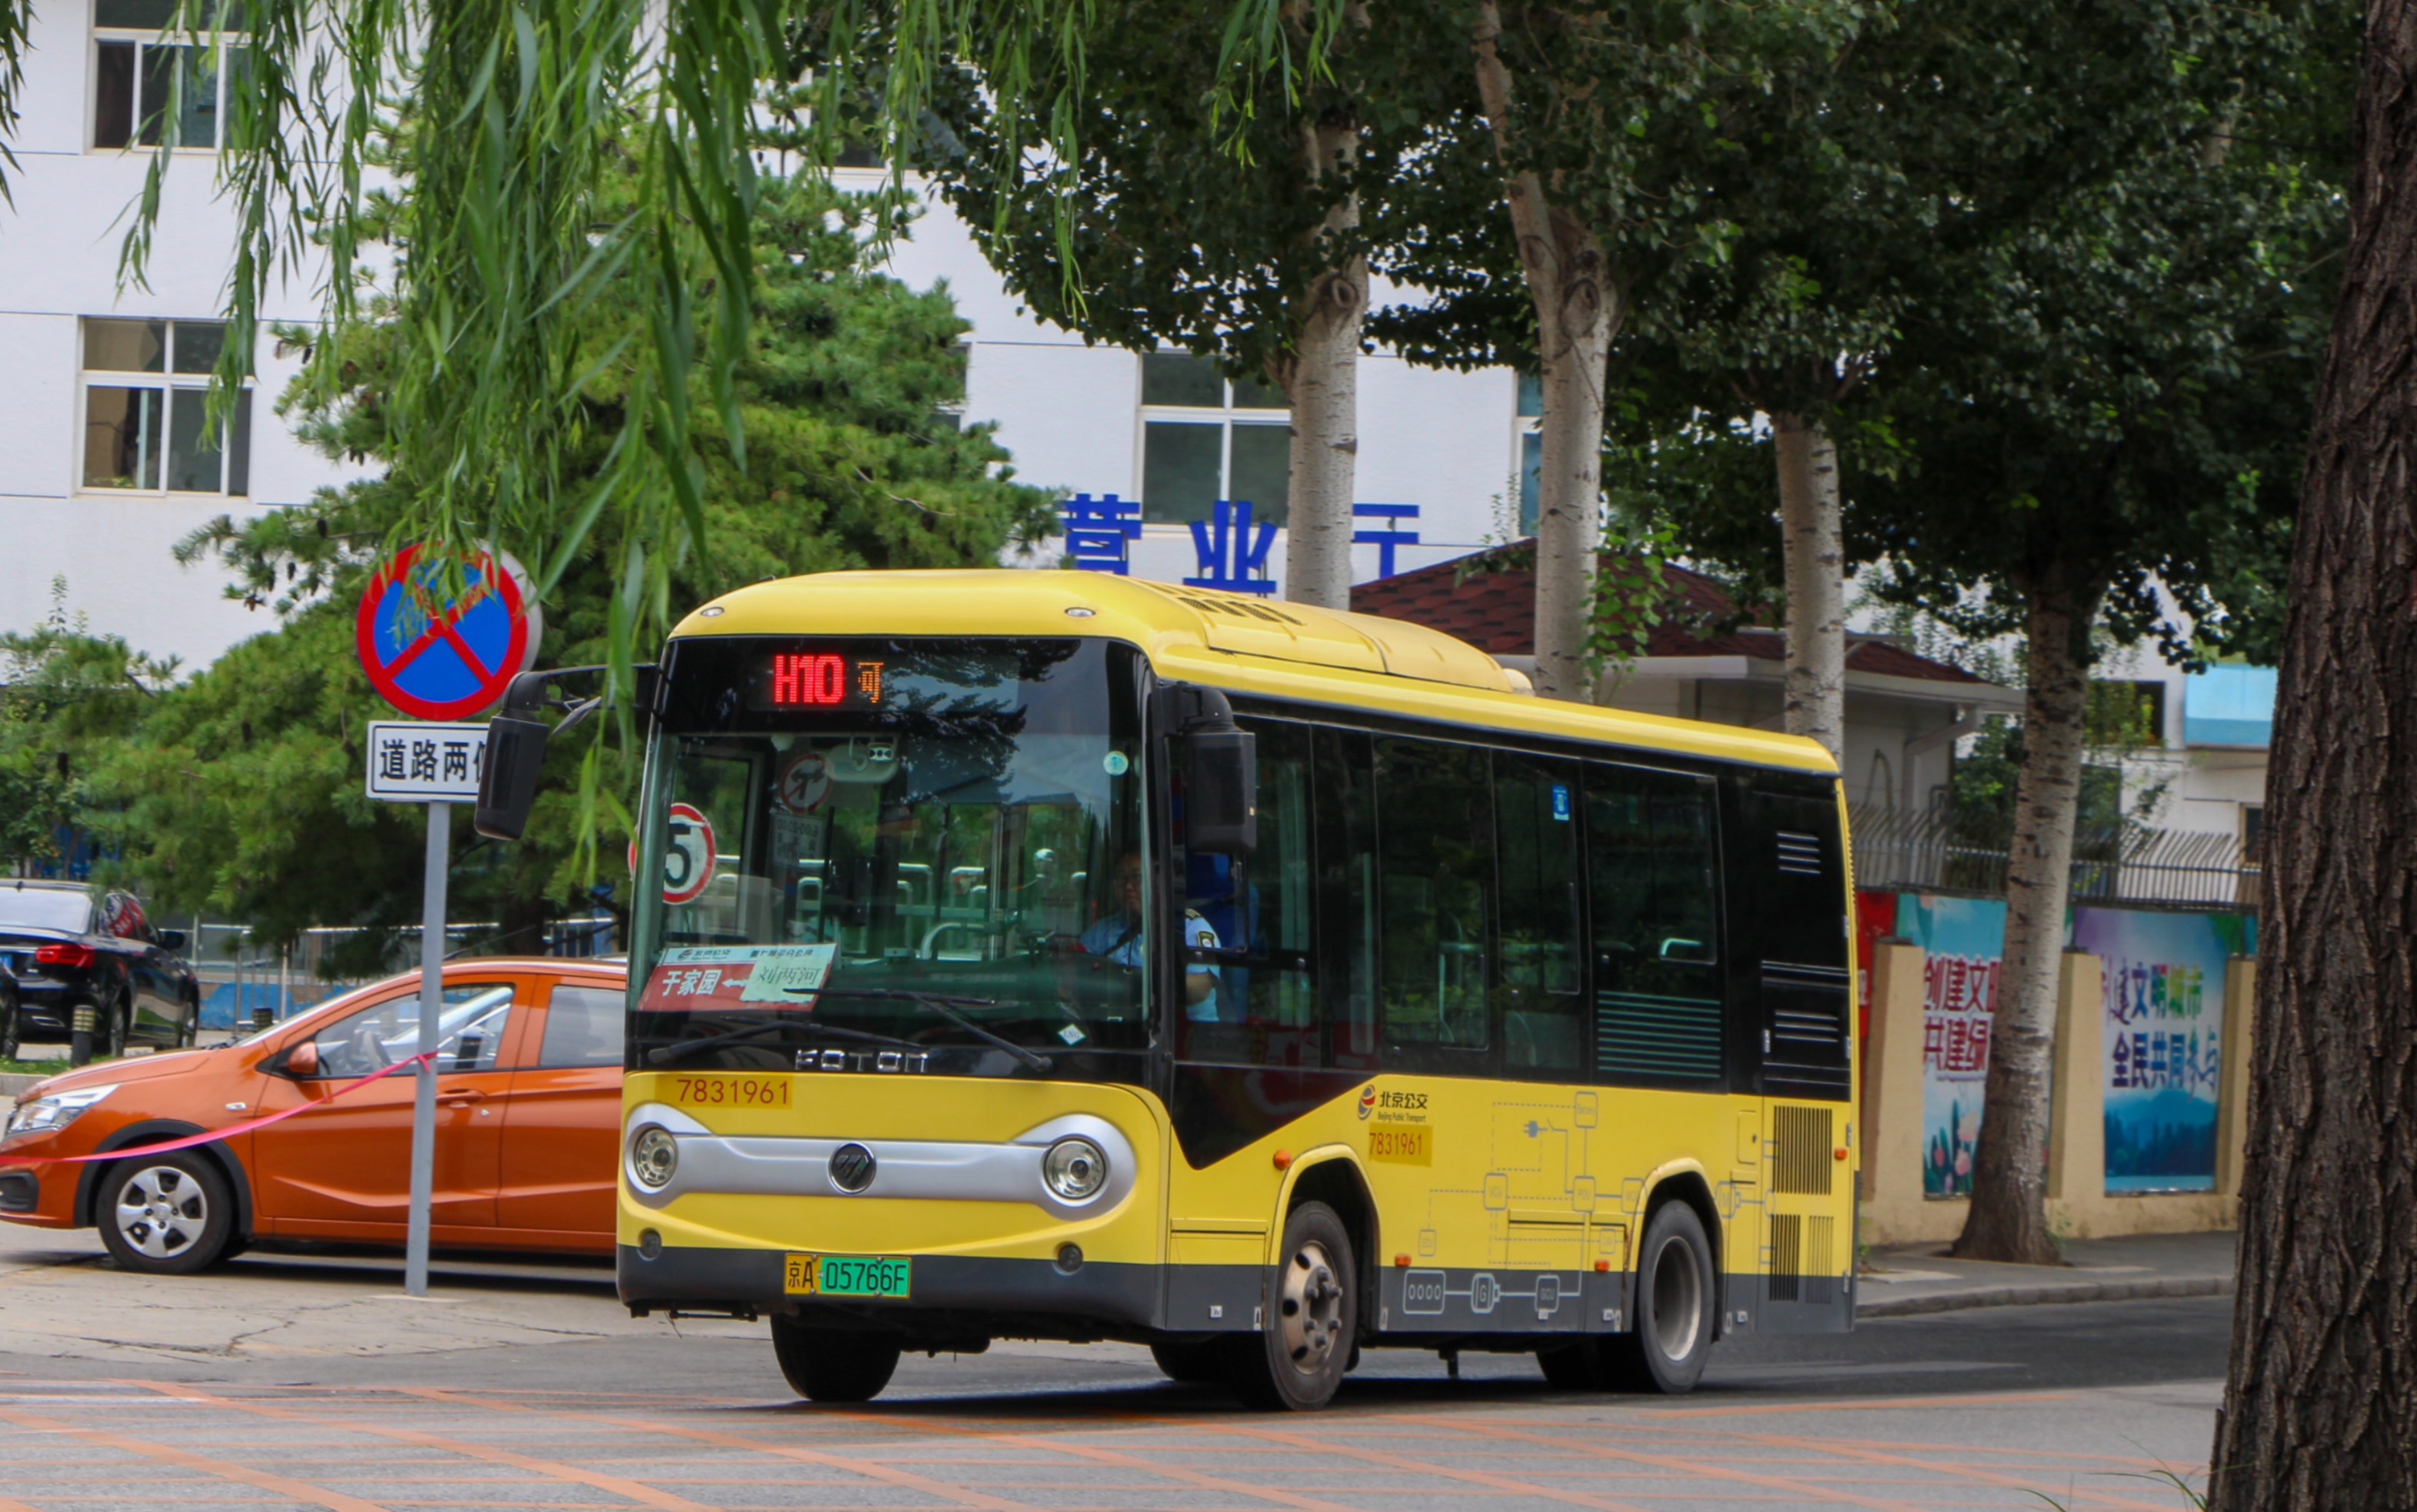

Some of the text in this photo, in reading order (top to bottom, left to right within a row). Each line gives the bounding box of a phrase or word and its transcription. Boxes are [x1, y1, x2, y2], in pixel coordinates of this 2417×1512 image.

[775, 654, 844, 704] H10
[662, 969, 723, 997] 于家园
[756, 965, 823, 986] 刘两河
[795, 1049, 929, 1073] FOTON
[677, 1078, 789, 1105] 7831961
[1379, 1091, 1428, 1109] 北京公交
[1369, 1132, 1422, 1155] 7831961
